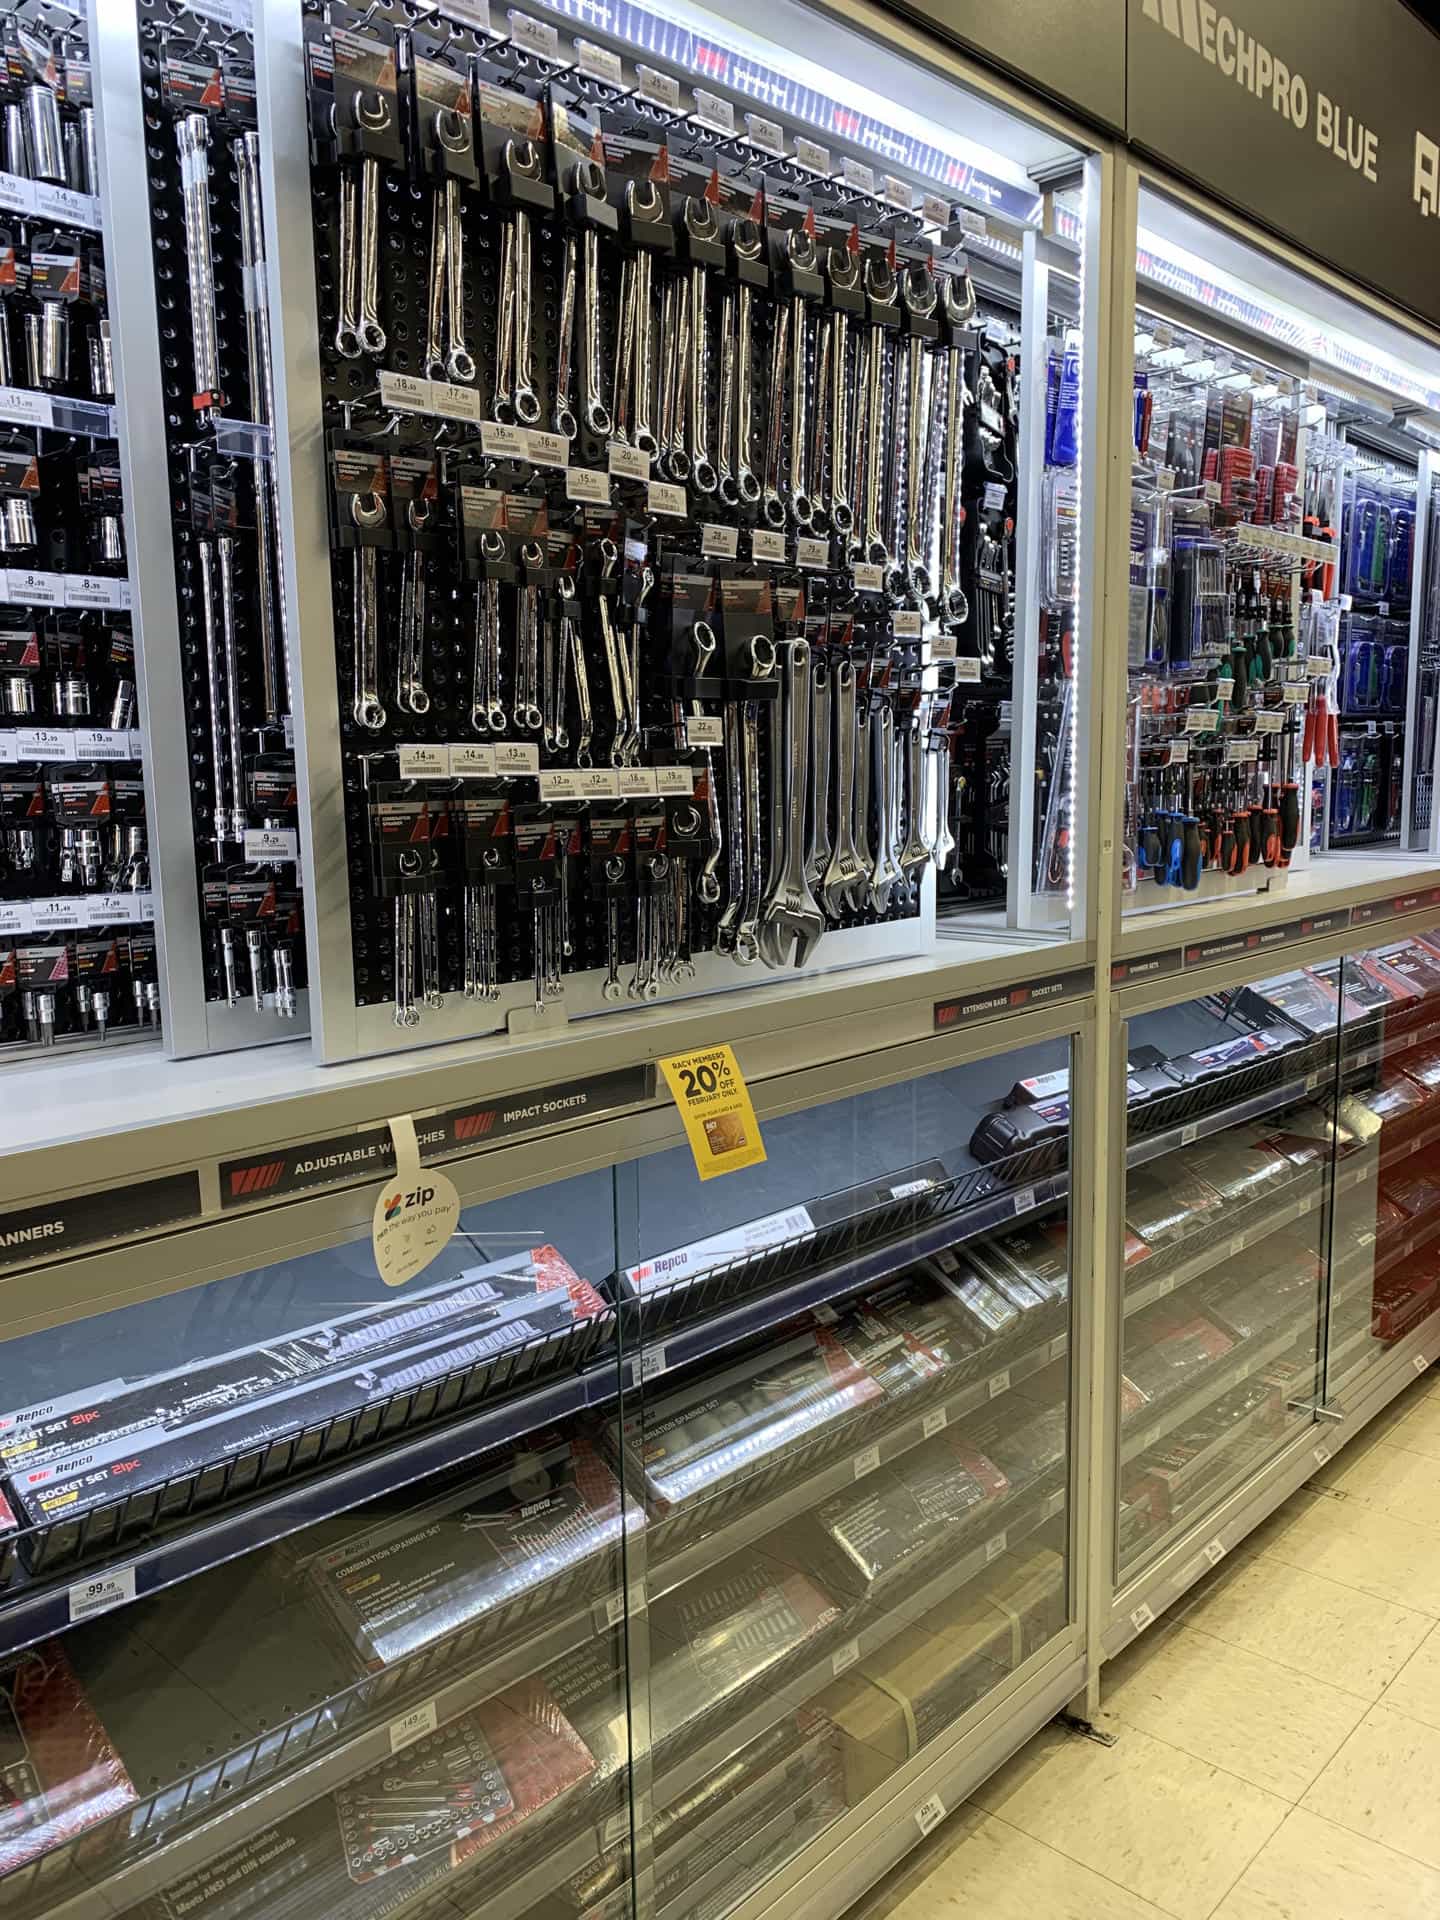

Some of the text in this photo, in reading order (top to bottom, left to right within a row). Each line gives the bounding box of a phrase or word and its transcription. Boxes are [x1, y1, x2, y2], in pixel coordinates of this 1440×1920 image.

[1317, 91, 1378, 183] BLUE
[1032, 987, 1050, 998] SOCKET
[962, 996, 1008, 1014] EXTENSION BARS
[672, 1051, 725, 1069] RACV MEMBERS
[679, 1060, 731, 1098] 20%
[719, 1079, 735, 1090] OFF
[503, 1093, 587, 1123] IMPACT SOCKETS
[688, 1088, 738, 1107] FEBRUARY ONLY
[295, 1130, 445, 1174] ADJUSTABLE WCHES
[405, 1186, 434, 1208] zip
[416, 1208, 433, 1220] you
[435, 1203, 452, 1215] pay
[654, 1252, 688, 1274] Repco
[16, 1406, 54, 1423] Repco
[45, 1421, 68, 1434] SET
[71, 1410, 101, 1425] 21pc
[632, 1419, 676, 1448] COMINATION
[56, 1455, 93, 1474] Repco
[37, 1460, 141, 1503] SOCKET SET 21pc
[335, 1524, 441, 1579] COMBINATION SPANNER SET
[204, 1878, 226, 1899] ANSI
[259, 1836, 296, 1864] standards
